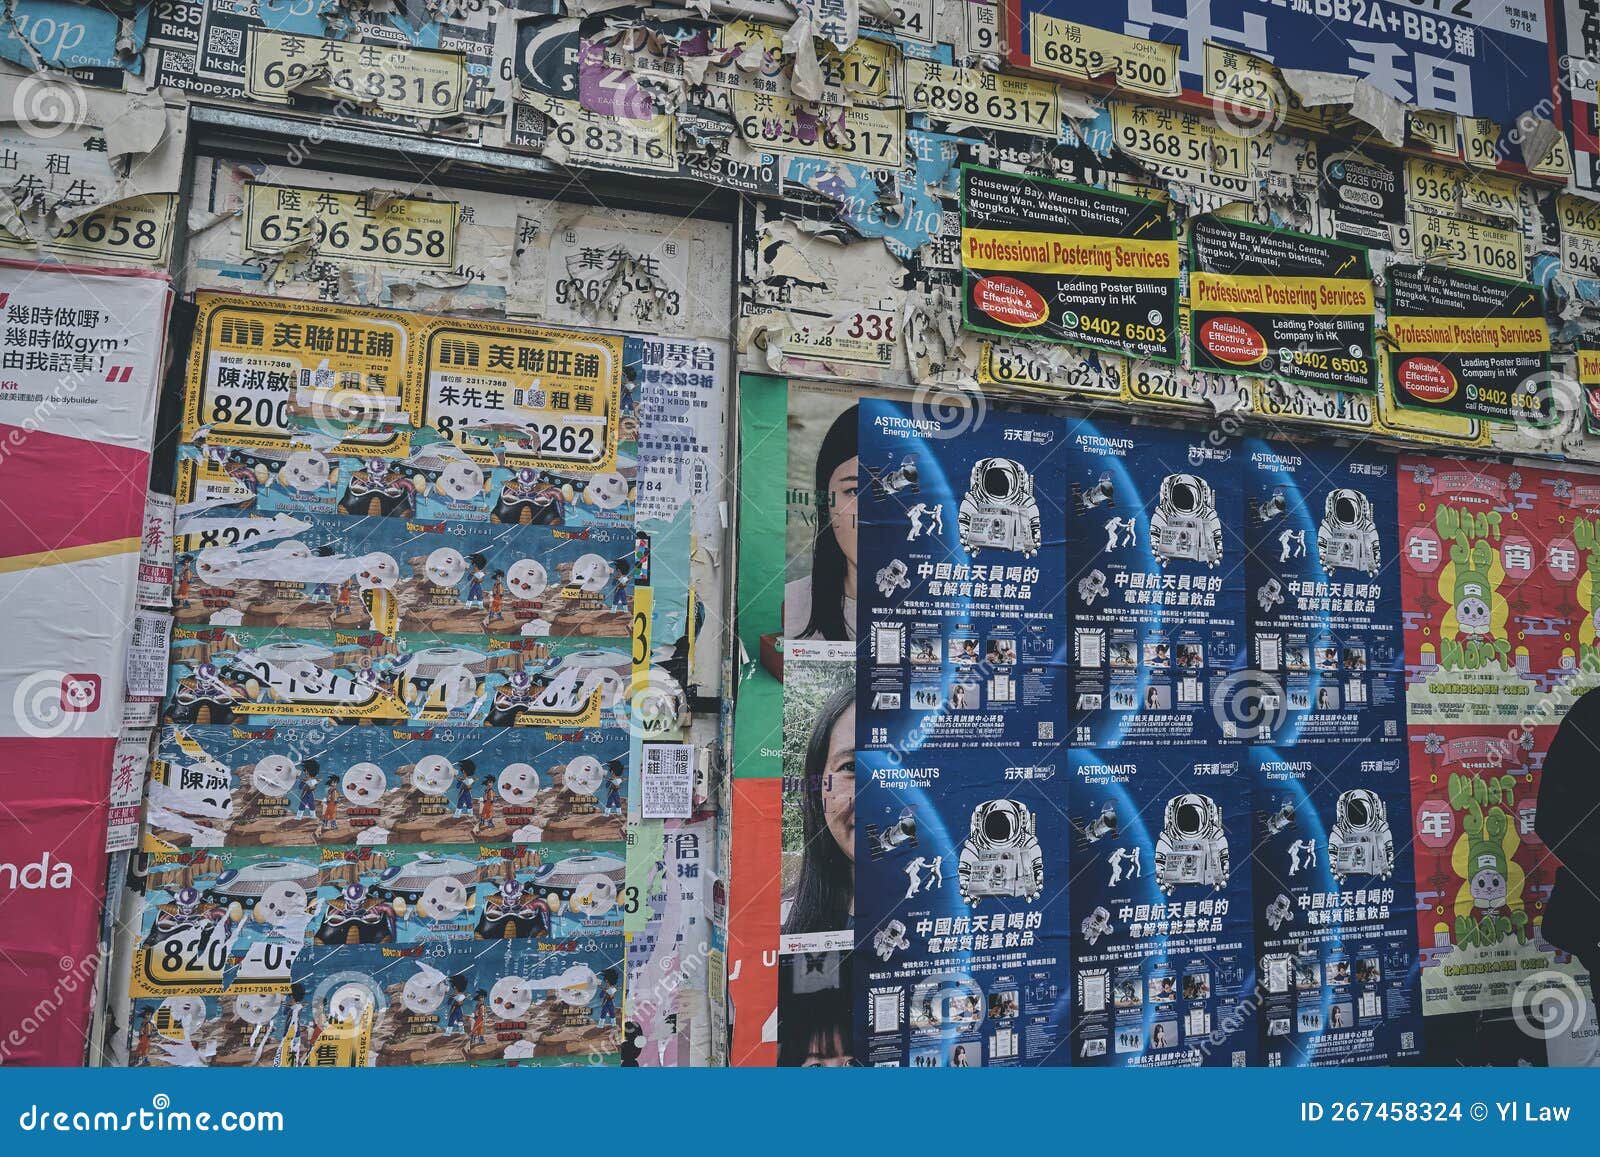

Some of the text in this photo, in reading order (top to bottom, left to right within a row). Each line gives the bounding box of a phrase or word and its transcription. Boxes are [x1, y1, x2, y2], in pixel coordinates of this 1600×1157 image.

[1044, 20, 1081, 43] 小楊
[1510, 19, 1532, 33] 9718
[280, 36, 382, 67] 李先生
[1132, 41, 1158, 55] JOHN
[1044, 41, 1167, 86] 6859 3500
[924, 63, 997, 91] 洪小姐
[1003, 80, 1029, 91] CHRIS
[366, 72, 452, 107] 8316
[914, 82, 1050, 125] 6898 6317
[1123, 126, 1182, 156] 9368
[691, 168, 758, 190] Ricky Chan
[728, 162, 773, 183] 0710
[971, 177, 1021, 195] Causeway
[1346, 173, 1394, 193] 6235 0710
[384, 204, 406, 214] JOE
[971, 188, 1008, 203] Sheung
[1039, 201, 1078, 215] Western
[1197, 223, 1237, 240] Causeway
[1427, 217, 1479, 240] 胡先生
[1482, 231, 1508, 240] GILBERT
[360, 224, 446, 258] 5658
[1197, 234, 1286, 258] Sheung Western
[970, 237, 1170, 271] Professional Postering Services
[1473, 244, 1517, 270] 1068
[1057, 281, 1167, 296] Leading Poster Billing
[1199, 280, 1366, 310] Professional Postering Services
[1442, 288, 1471, 301] Western
[983, 291, 1033, 309] Effective &
[1058, 293, 1136, 306] Company in HK
[982, 302, 1038, 319] Economical
[1079, 315, 1166, 343] 9402 6503
[1272, 320, 1365, 331] Leading Poster Billing
[4, 327, 128, 353] 幾時做gym，
[272, 322, 393, 357] 美聯旺舖
[1063, 329, 1166, 353] call Raymond for details
[1209, 332, 1253, 346] Effective &
[1273, 331, 1338, 343] Company in HK
[1395, 324, 1542, 348] Professional Postering Services
[1209, 343, 1258, 356] Economical
[2, 350, 104, 373] 由我話事！
[488, 344, 599, 378] 美聯旺舖
[1294, 351, 1368, 374] 9402 6503
[1460, 358, 1541, 369] Leading Poster Billing
[217, 366, 289, 392] 陳淑敏
[1280, 365, 1368, 385] call Raymond for details
[1405, 372, 1439, 383] Effective
[1462, 368, 1518, 379] Company HK
[1, 381, 18, 390] Kit
[1405, 382, 1449, 394] Economical
[439, 385, 504, 411] 朱先生
[551, 391, 593, 412] 租售
[1479, 387, 1541, 410] 9402 6503
[1465, 402, 1508, 416] call Raymond
[874, 416, 940, 431] ASTRONAUTS
[883, 427, 932, 438] Energy Drink
[1076, 435, 1133, 449] ASTRONAUTS
[1083, 445, 1126, 456] Energy Drink
[1251, 452, 1301, 465] ASTRONAUTS
[1258, 462, 1296, 472] Energy Drink
[1409, 536, 1438, 563] 年
[1505, 544, 1531, 570] 宵
[1549, 547, 1576, 572] 年
[917, 562, 1039, 584] 中國航天員喝的
[1115, 572, 1222, 592] 中國航天員喝的
[928, 582, 1032, 600] 電解質能量飲品
[1124, 589, 1216, 606] 電解質能量飲品
[1288, 580, 1381, 599] 中國航天員喝的
[1297, 597, 1375, 613] 電解質能量飲品
[872, 768, 940, 780] ASTRONAUTS
[1077, 764, 1136, 775] ASTRONAUTS
[1260, 761, 1312, 771] ASTRONAUTS
[1267, 771, 1305, 780] Energy Drink
[880, 779, 931, 789] Energy Drink
[1085, 775, 1129, 785] Energy Drink
[1421, 810, 1451, 839] 年
[1298, 888, 1394, 910] 中國航天員喝的
[1119, 898, 1229, 923] 中國航天員喝的
[1307, 906, 1389, 924] 電解質能量飲品
[916, 911, 1042, 937] 中國航天員喝的
[1129, 917, 1223, 938] 電解質能量飲品
[928, 931, 1034, 954] 電解質能量飲品
